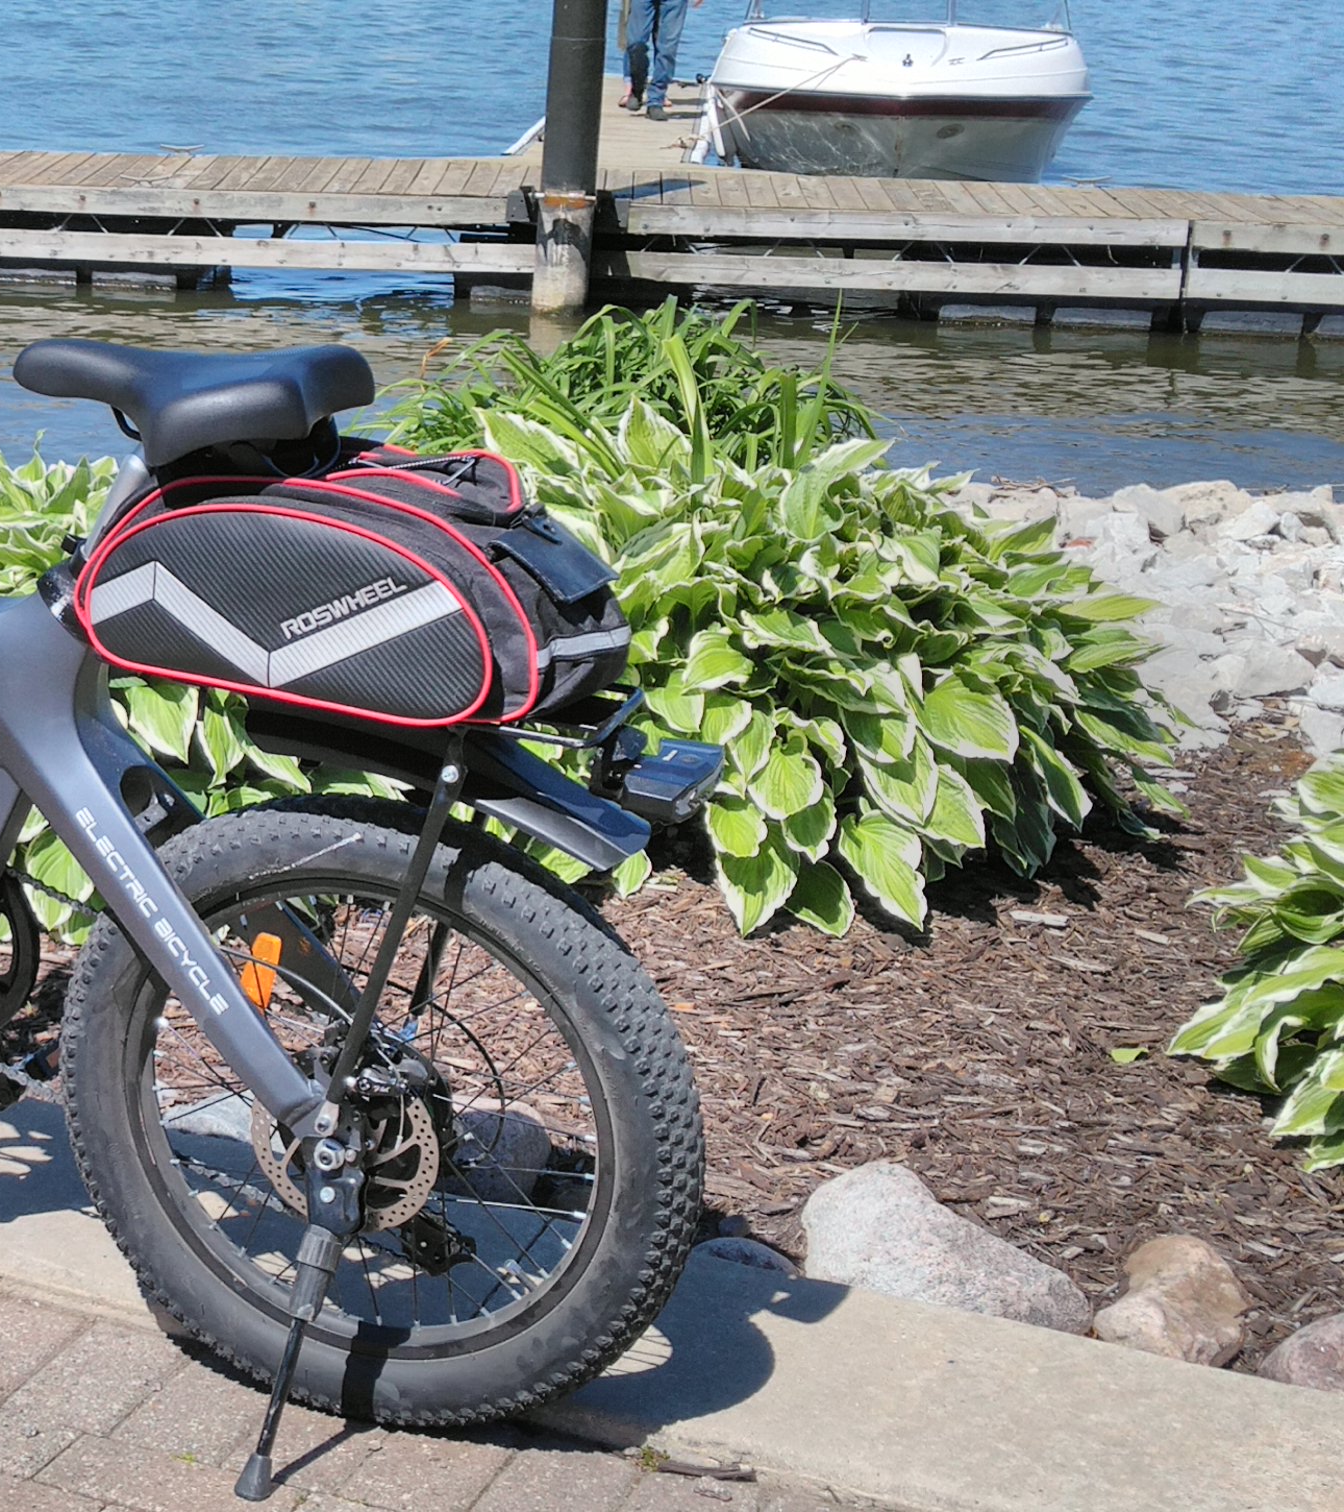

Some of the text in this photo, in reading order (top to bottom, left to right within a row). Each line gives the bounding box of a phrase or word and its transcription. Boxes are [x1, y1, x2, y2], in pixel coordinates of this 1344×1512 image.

[279, 576, 408, 640] ROSWHEEL
[75, 807, 230, 1016] ELECTRIC BICYCLE
